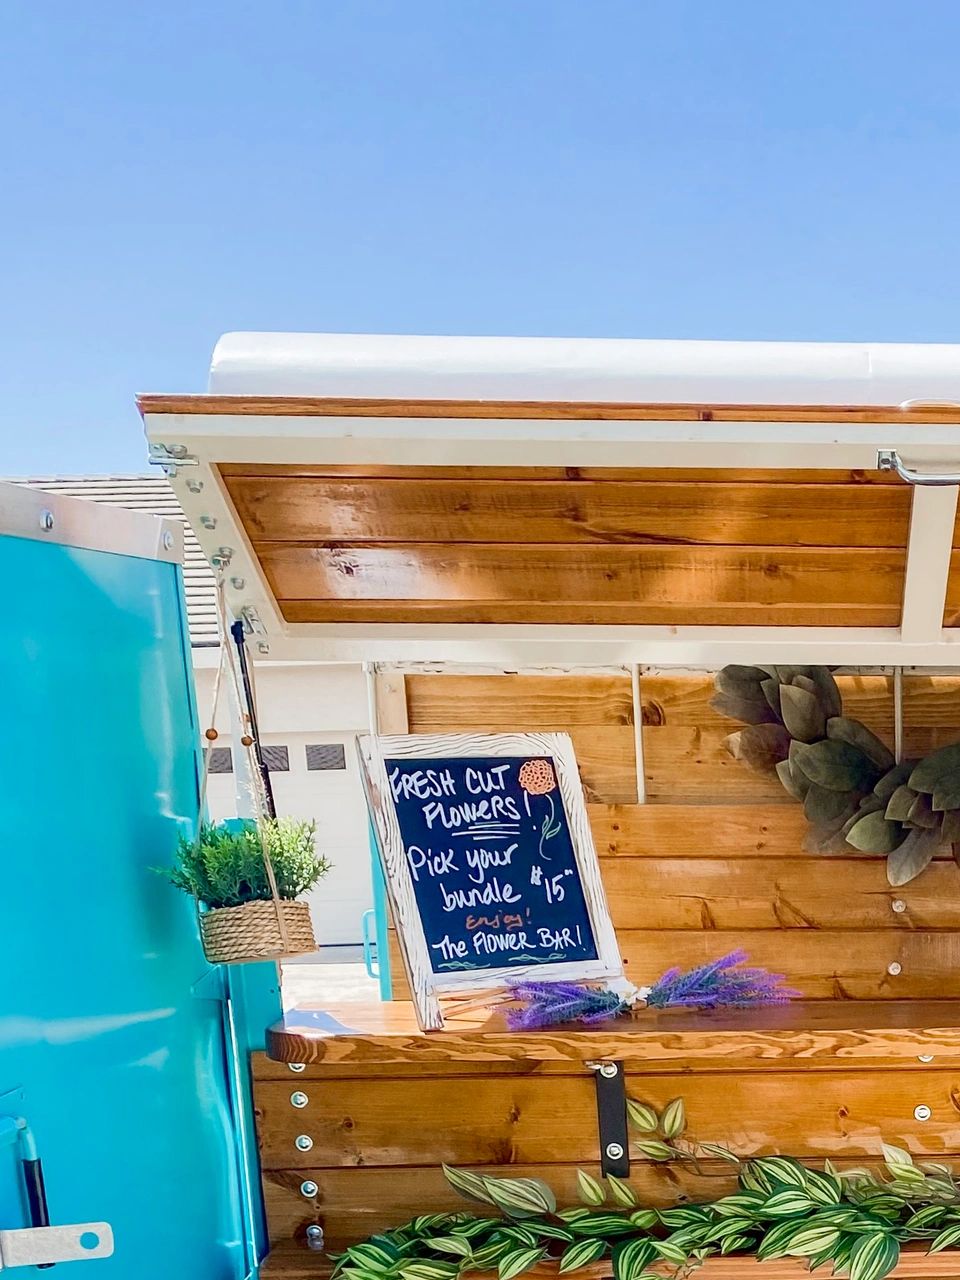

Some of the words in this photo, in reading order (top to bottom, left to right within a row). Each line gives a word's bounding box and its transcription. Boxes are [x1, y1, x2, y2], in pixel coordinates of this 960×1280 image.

[388, 767, 455, 803] FRESH
[465, 764, 511, 794] CUT
[407, 844, 459, 881] Pick
[466, 843, 519, 884] your
[442, 880, 522, 912] bundle
[432, 934, 469, 960] The
